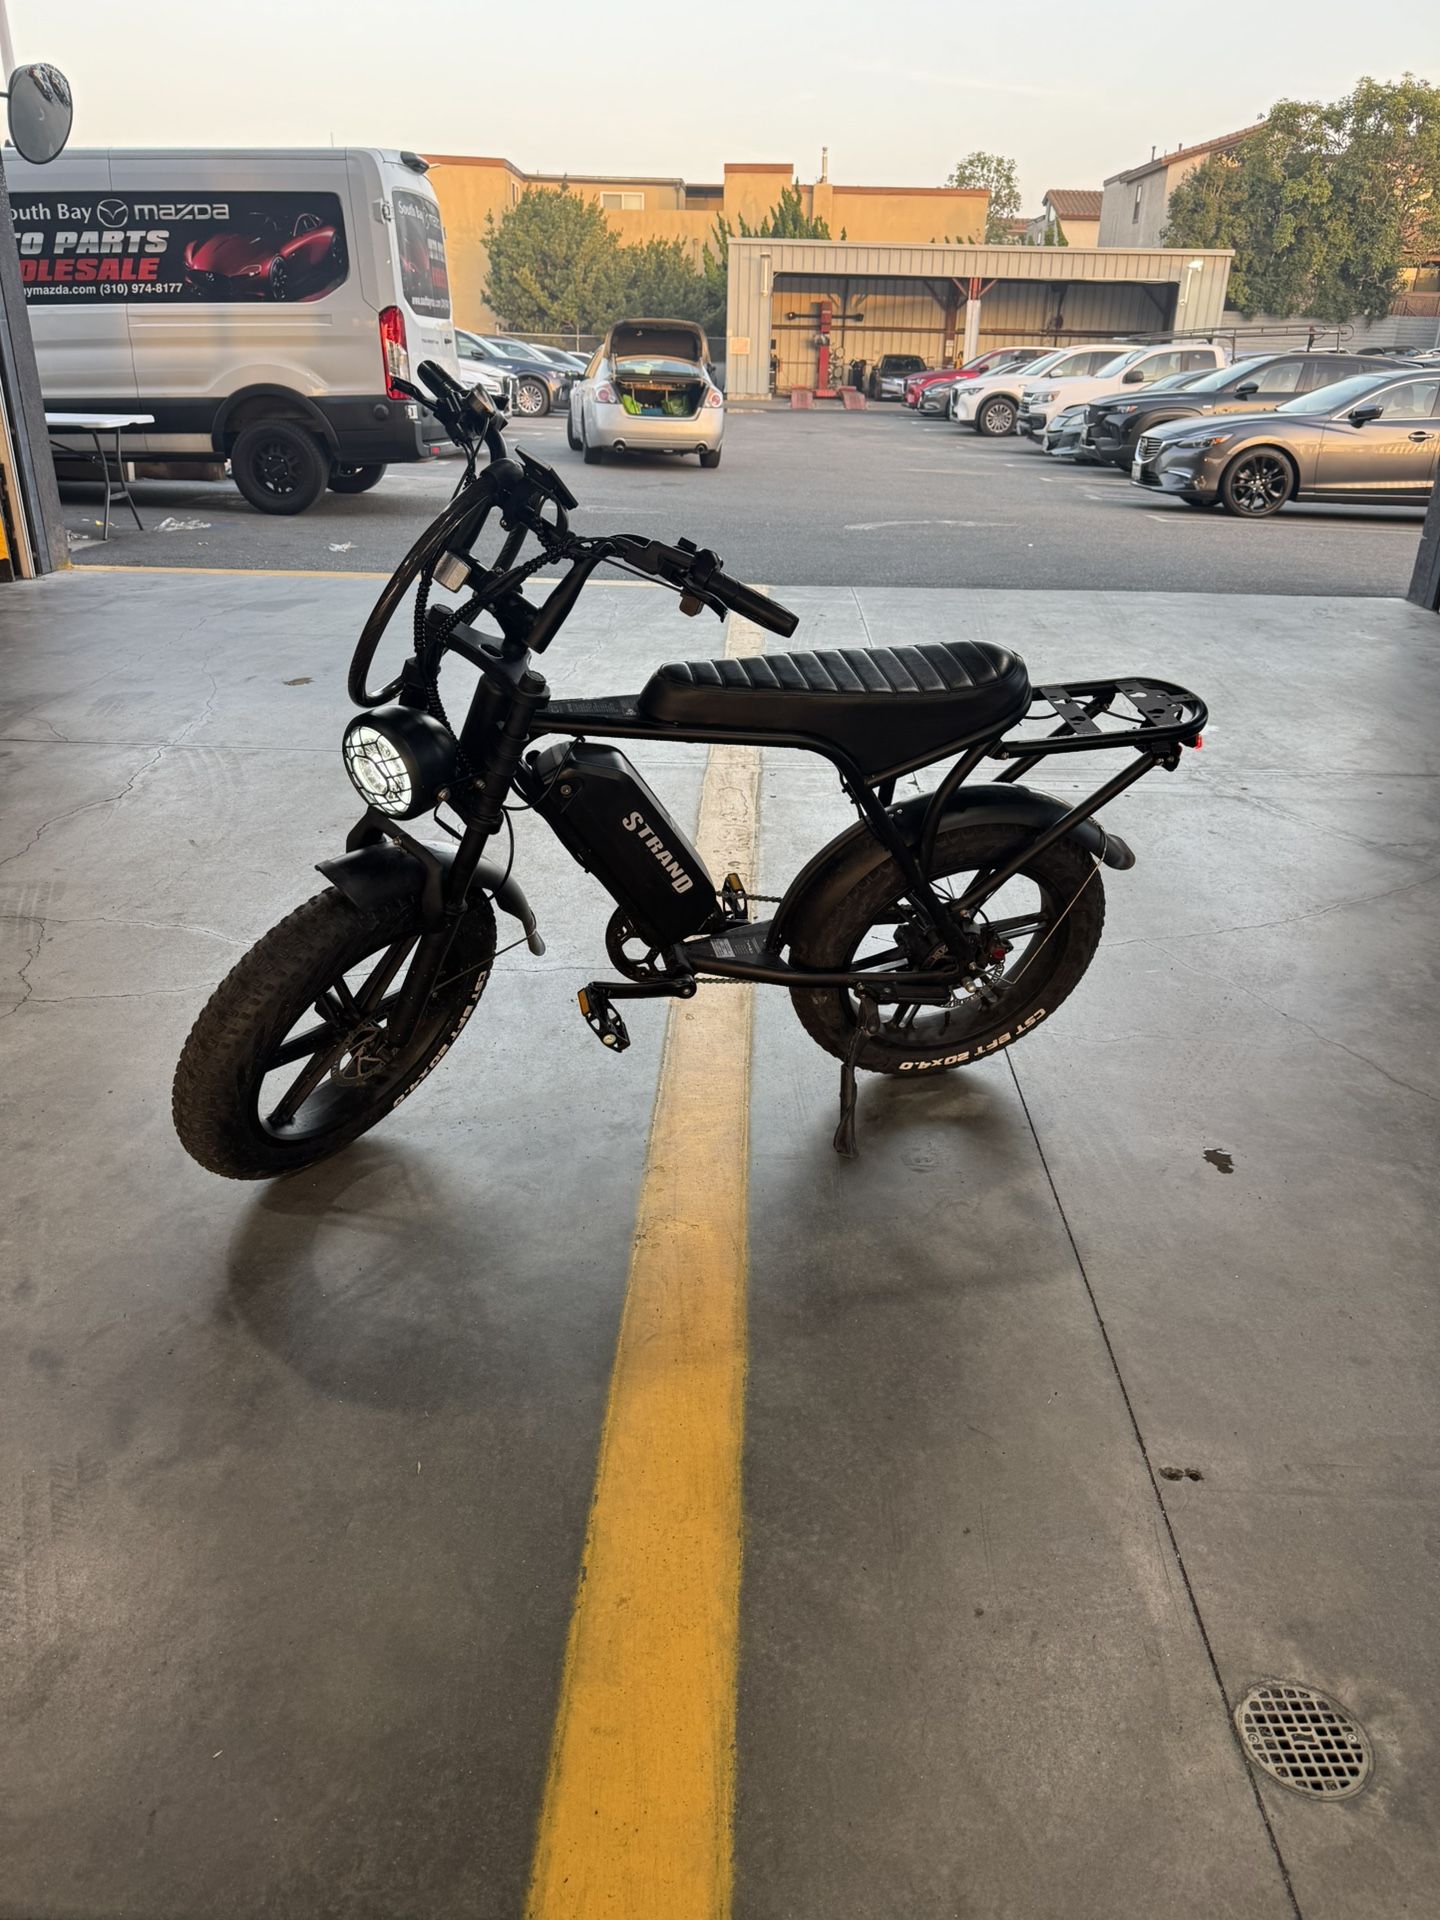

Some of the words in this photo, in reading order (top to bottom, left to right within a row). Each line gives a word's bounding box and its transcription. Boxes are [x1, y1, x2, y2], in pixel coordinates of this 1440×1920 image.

[57, 203, 92, 224] Bay
[54, 230, 170, 254] PARTS
[100, 283, 128, 296] (310)
[131, 283, 183, 294] 974-8177
[622, 811, 693, 893] STRAND
[1015, 1008, 1046, 1035] CST
[974, 1031, 1012, 1056] BFT
